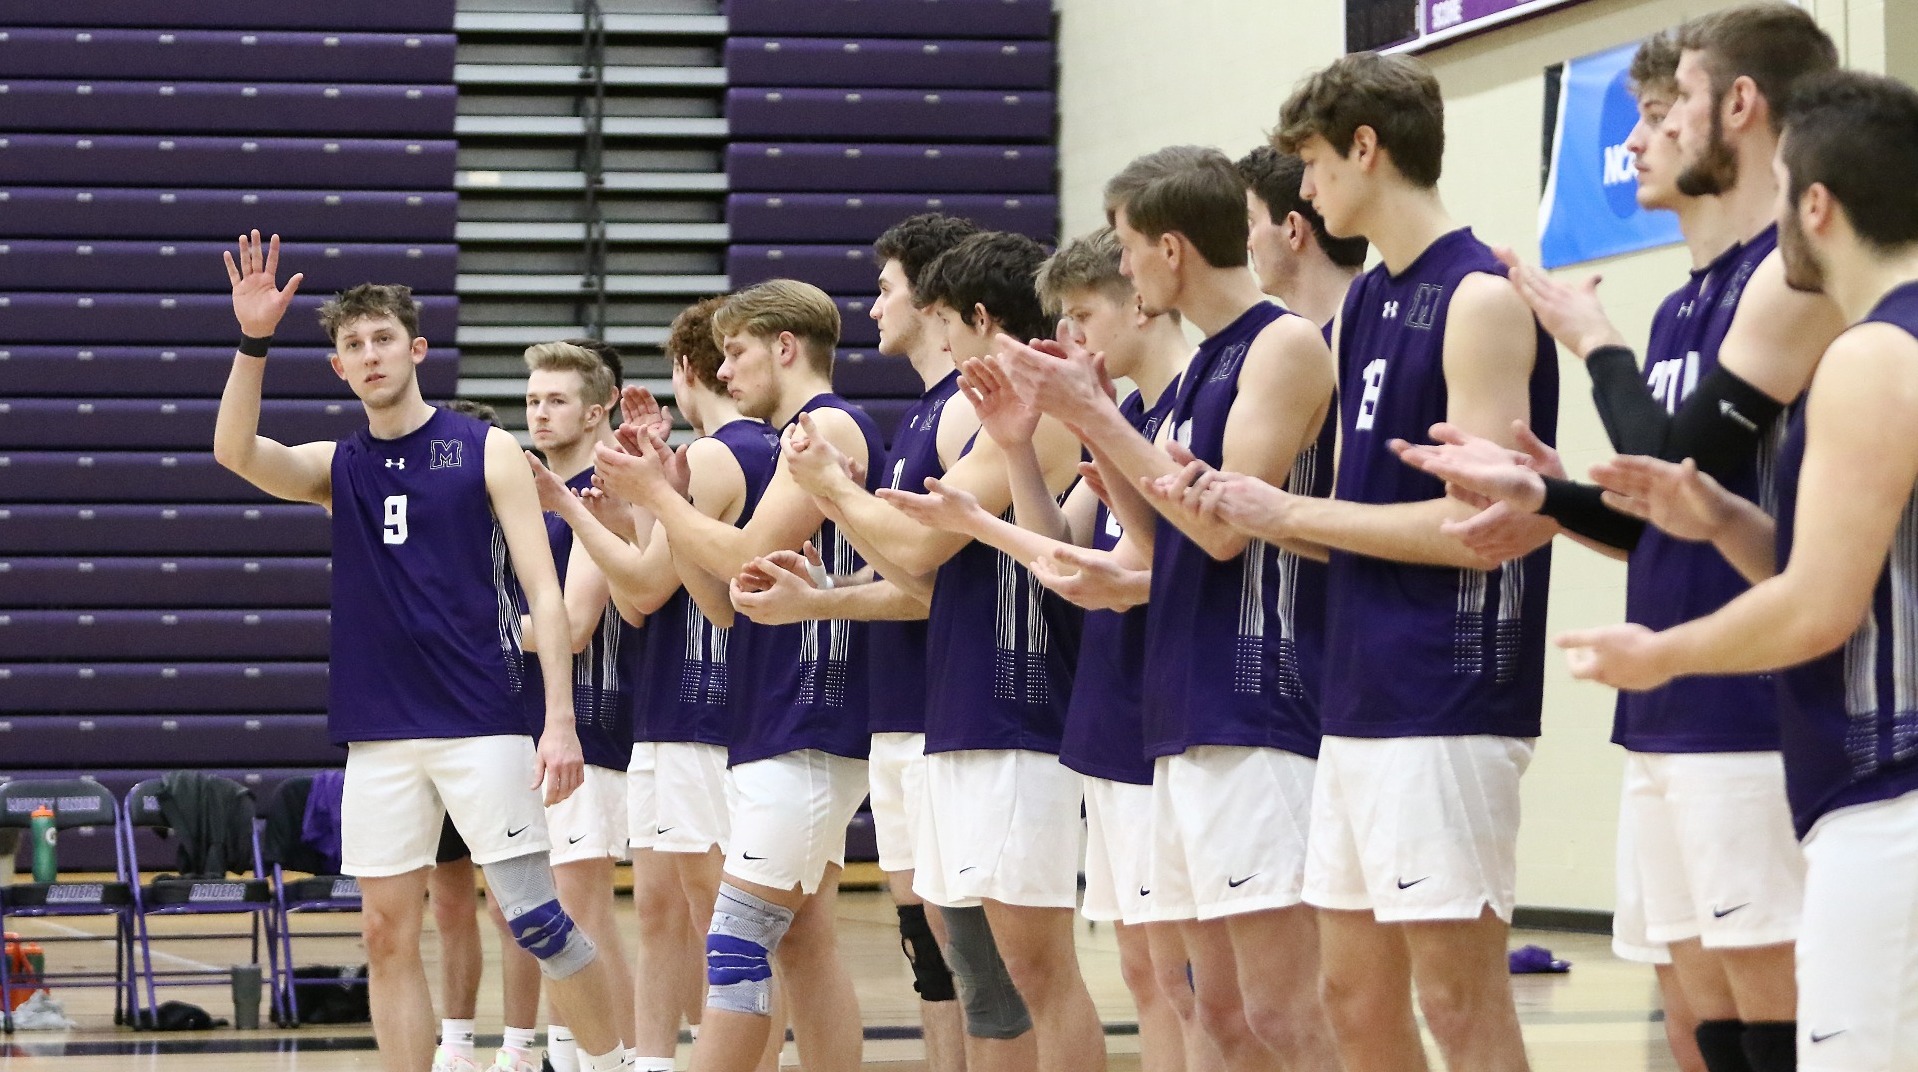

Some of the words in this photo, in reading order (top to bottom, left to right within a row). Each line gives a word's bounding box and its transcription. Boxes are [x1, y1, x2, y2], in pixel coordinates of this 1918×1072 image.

[427, 439, 463, 470] M
[383, 494, 408, 545] 9
[46, 884, 103, 903] RAIDERS
[189, 883, 246, 901] RAIDERS
